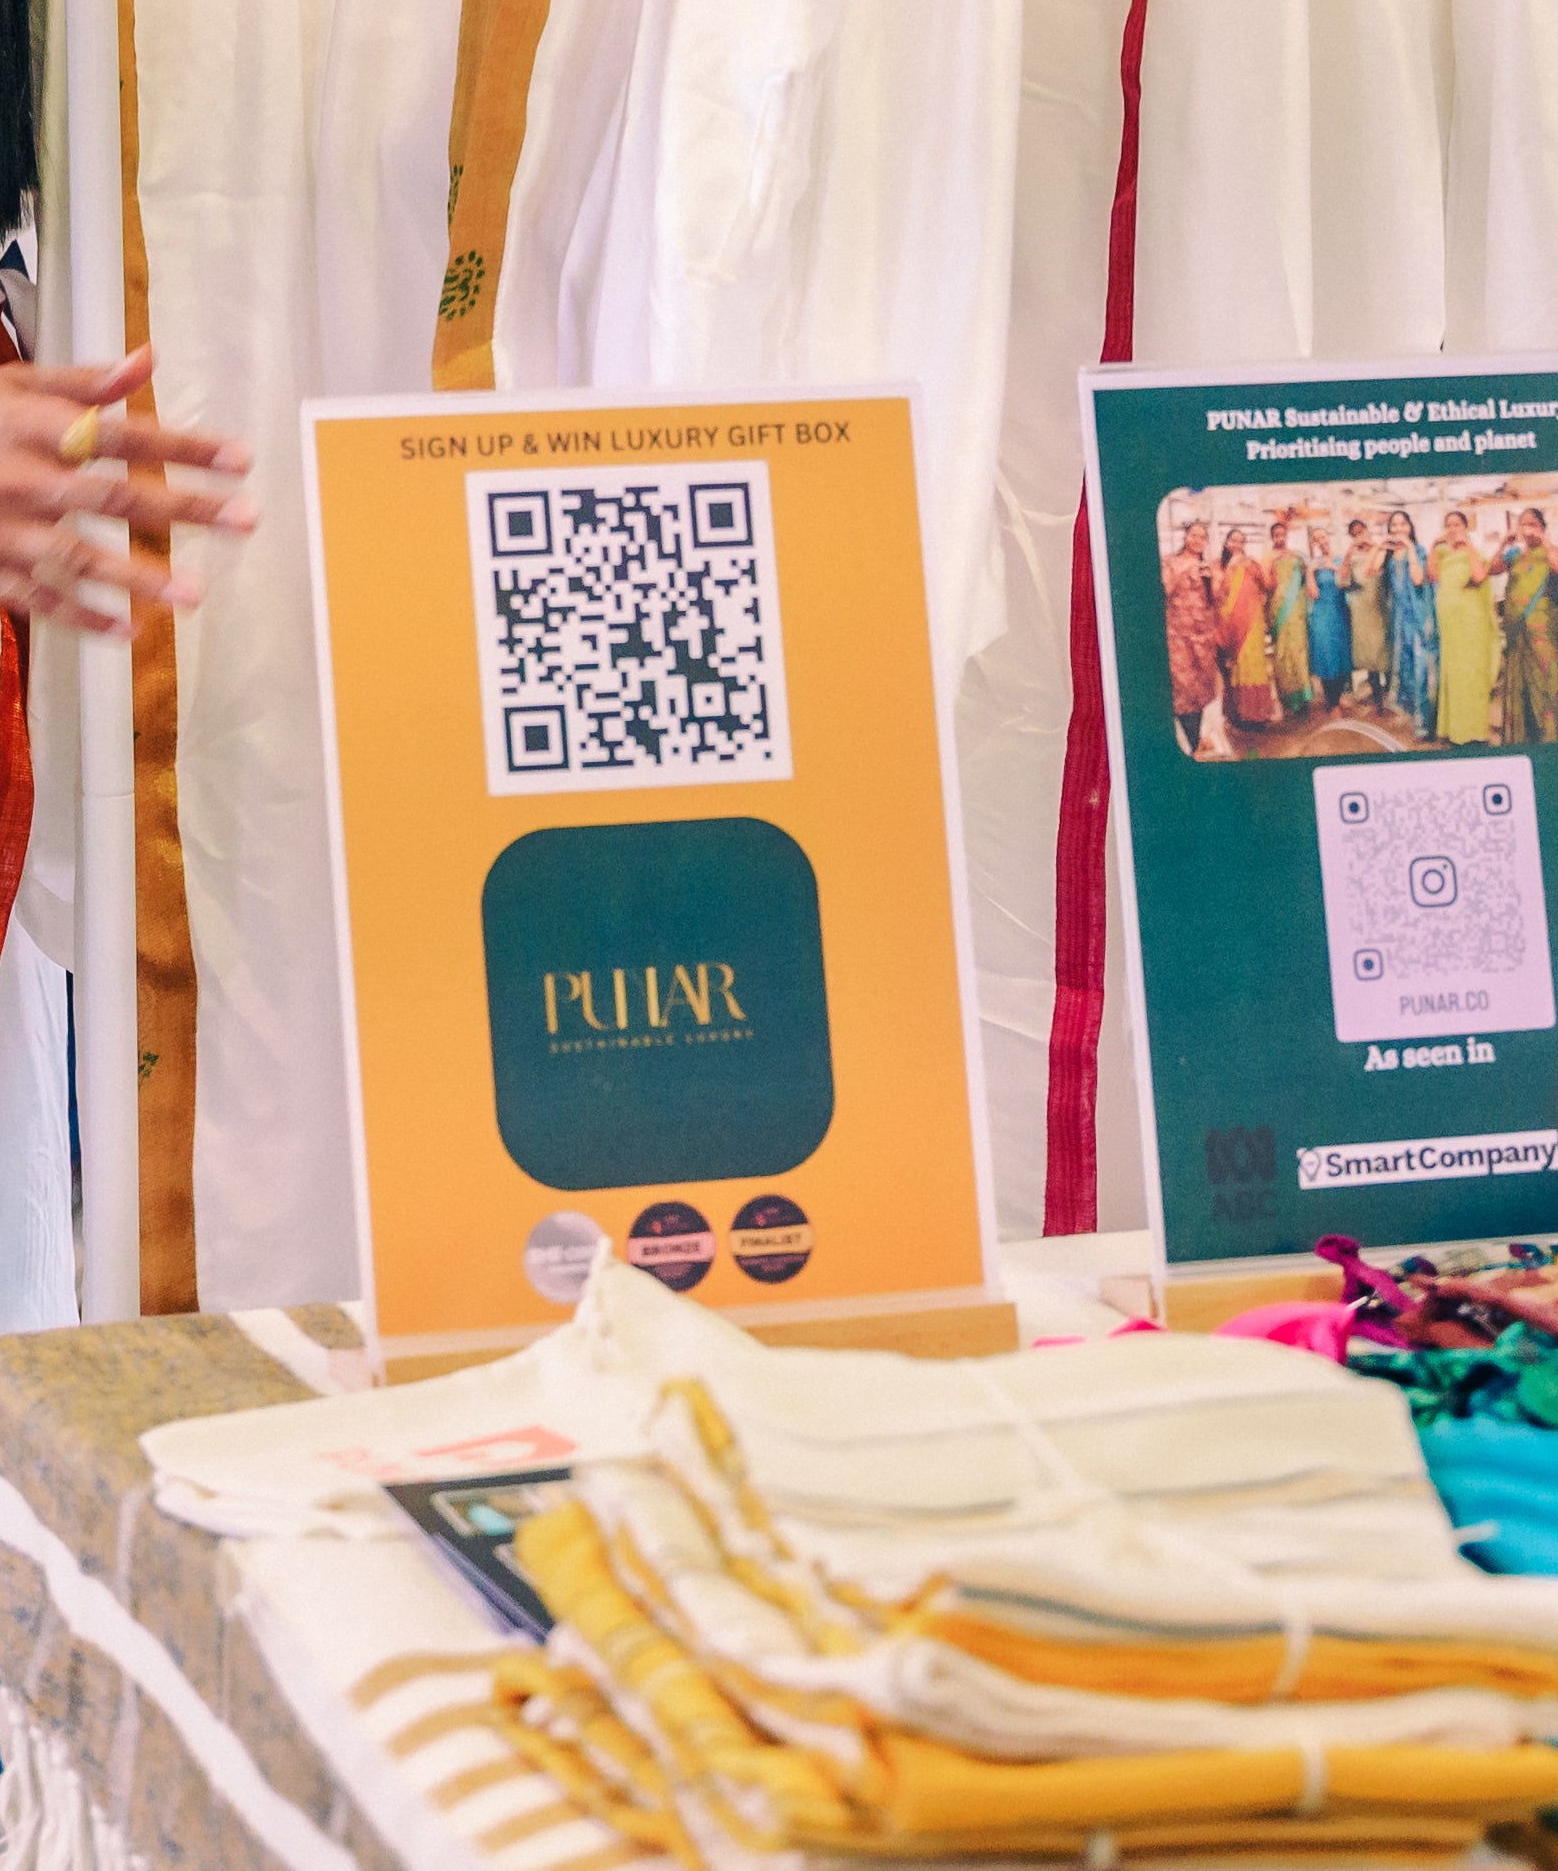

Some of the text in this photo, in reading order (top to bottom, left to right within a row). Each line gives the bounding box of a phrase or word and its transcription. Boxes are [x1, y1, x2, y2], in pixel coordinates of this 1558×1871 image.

[1207, 408, 1283, 431] PUNAR
[1284, 401, 1401, 428] Sustainable
[1403, 400, 1424, 423] &
[1427, 397, 1497, 422] Ethical
[401, 421, 851, 460] SIGN UP & WIN LUXURY GIFT BOX
[1247, 428, 1538, 461] Prioritising people and planet
[543, 961, 747, 1035] PUNAR
[1399, 990, 1490, 1016] PUNAR.CO
[1363, 1035, 1496, 1073] As seen in
[1325, 1143, 1558, 1180] SmartCompany
